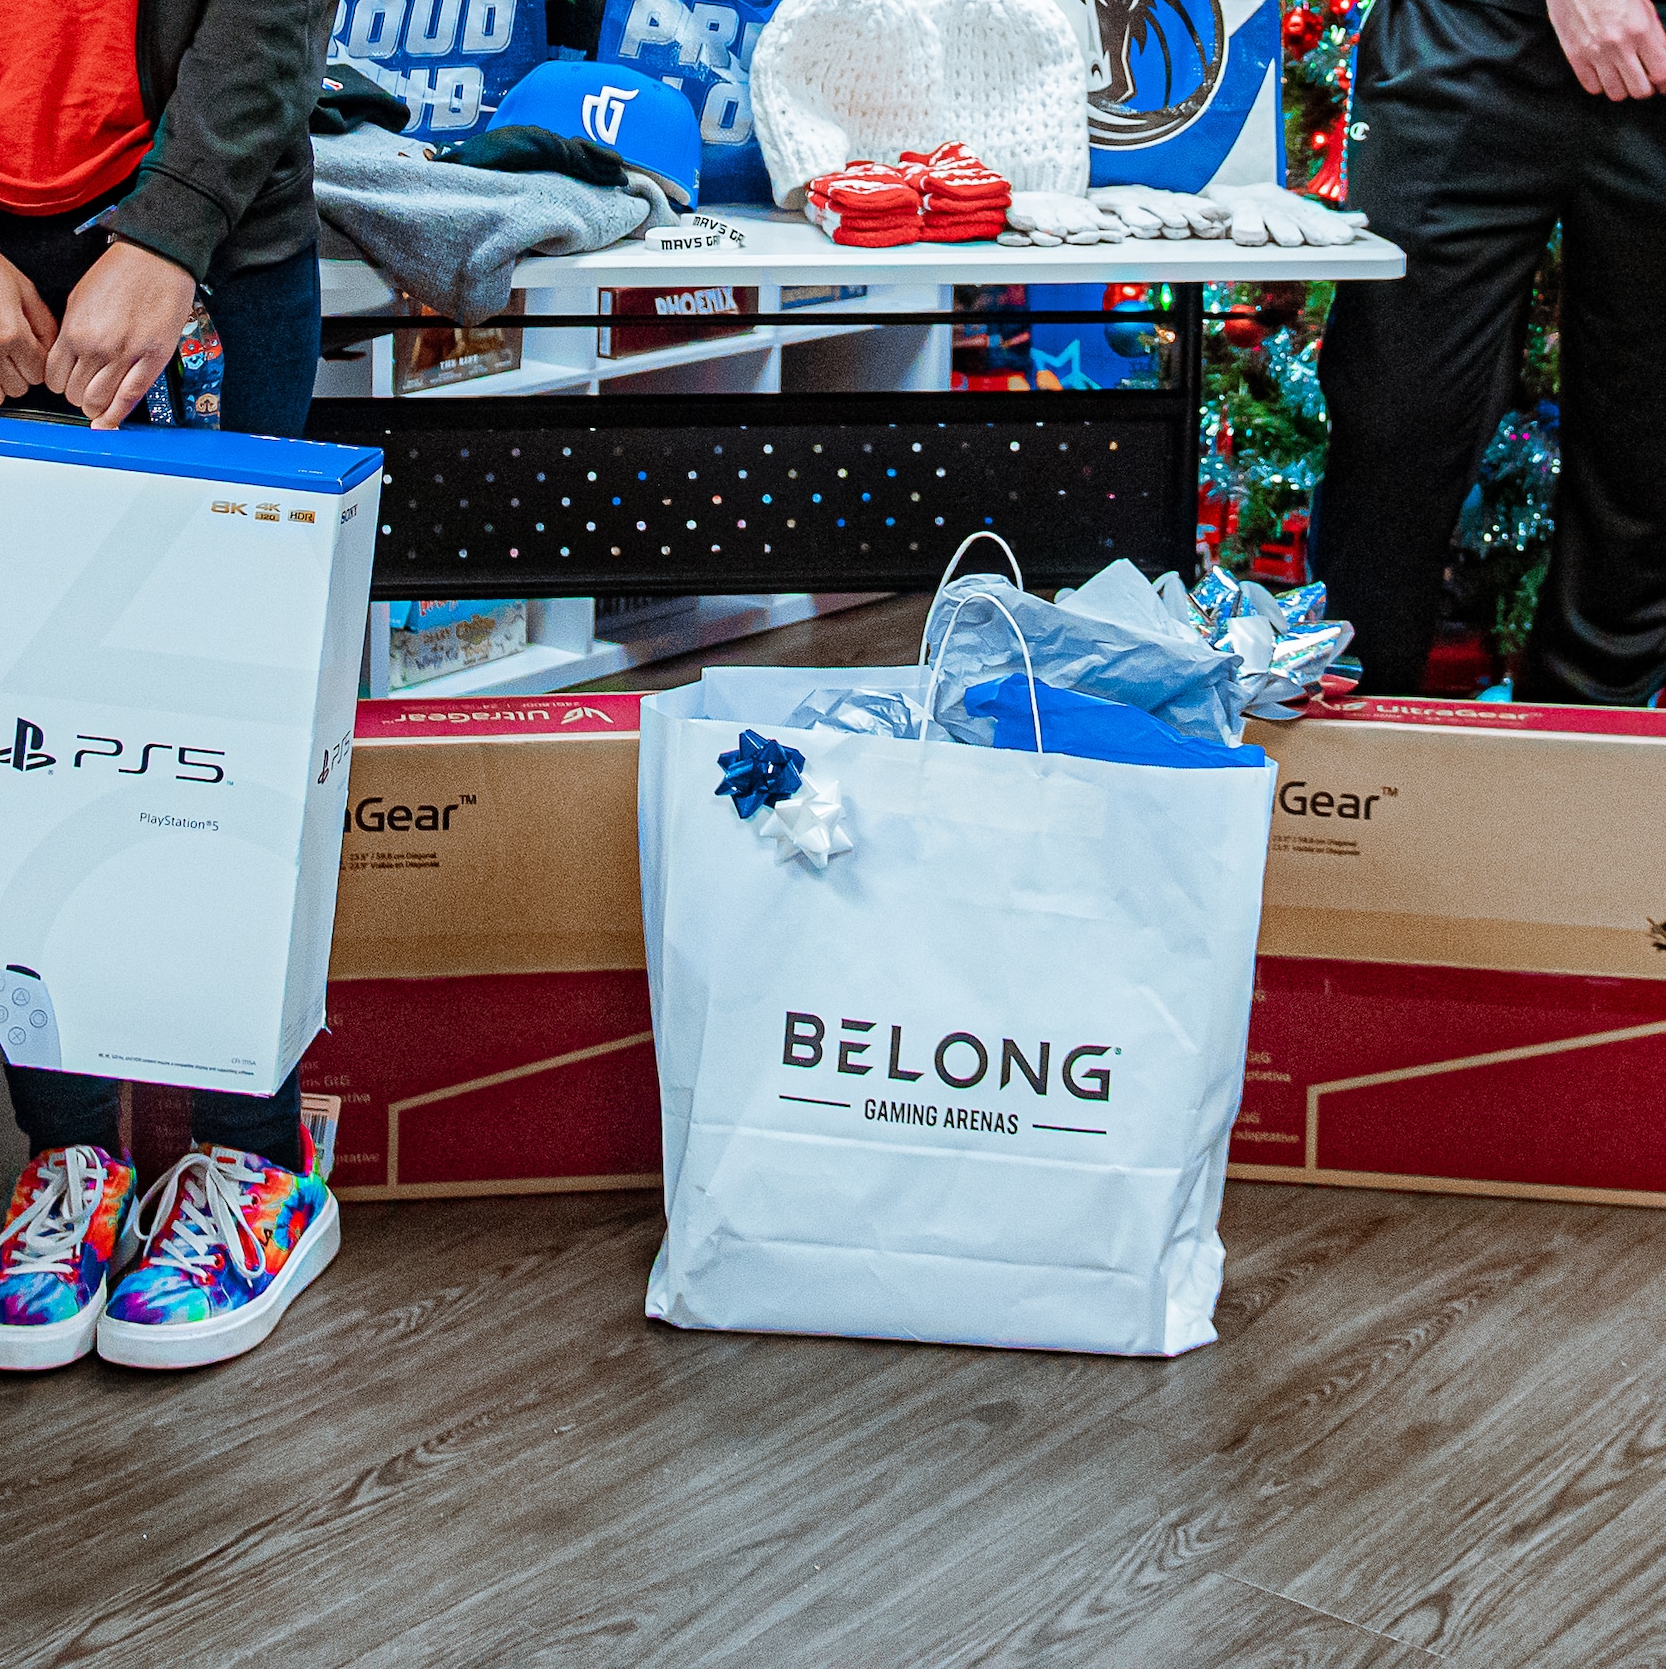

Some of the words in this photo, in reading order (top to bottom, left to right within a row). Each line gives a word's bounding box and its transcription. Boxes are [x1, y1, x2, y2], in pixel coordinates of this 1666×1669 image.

[661, 236, 702, 250] MAVS
[210, 500, 248, 516] 8K
[255, 502, 281, 512] 4K
[289, 511, 314, 522] HDR
[73, 734, 226, 784] PS5
[782, 1010, 1113, 1103] BELONG
[864, 1097, 938, 1128] GAMING
[942, 1103, 1021, 1135] ARENAS
